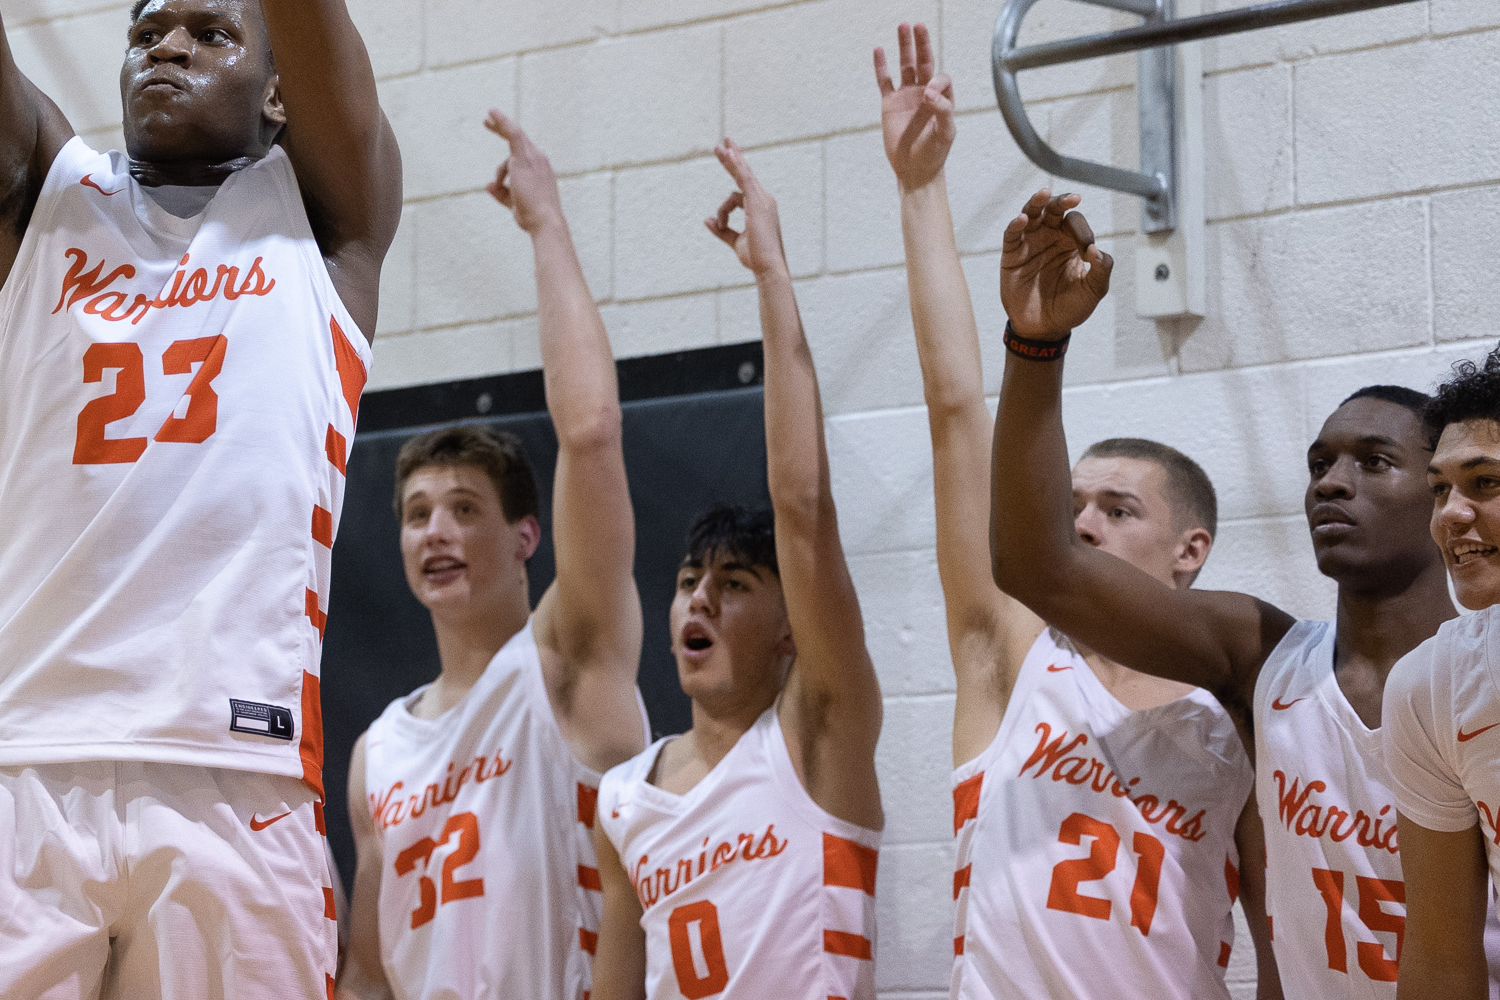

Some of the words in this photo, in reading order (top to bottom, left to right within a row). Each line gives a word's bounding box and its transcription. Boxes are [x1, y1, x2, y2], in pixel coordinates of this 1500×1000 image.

[51, 247, 276, 325] Wariors
[72, 334, 228, 465] 23
[277, 715, 285, 729] L
[394, 811, 485, 930] 32
[1046, 812, 1166, 937] 21
[1311, 867, 1407, 982] 15
[668, 899, 729, 1000] 0
